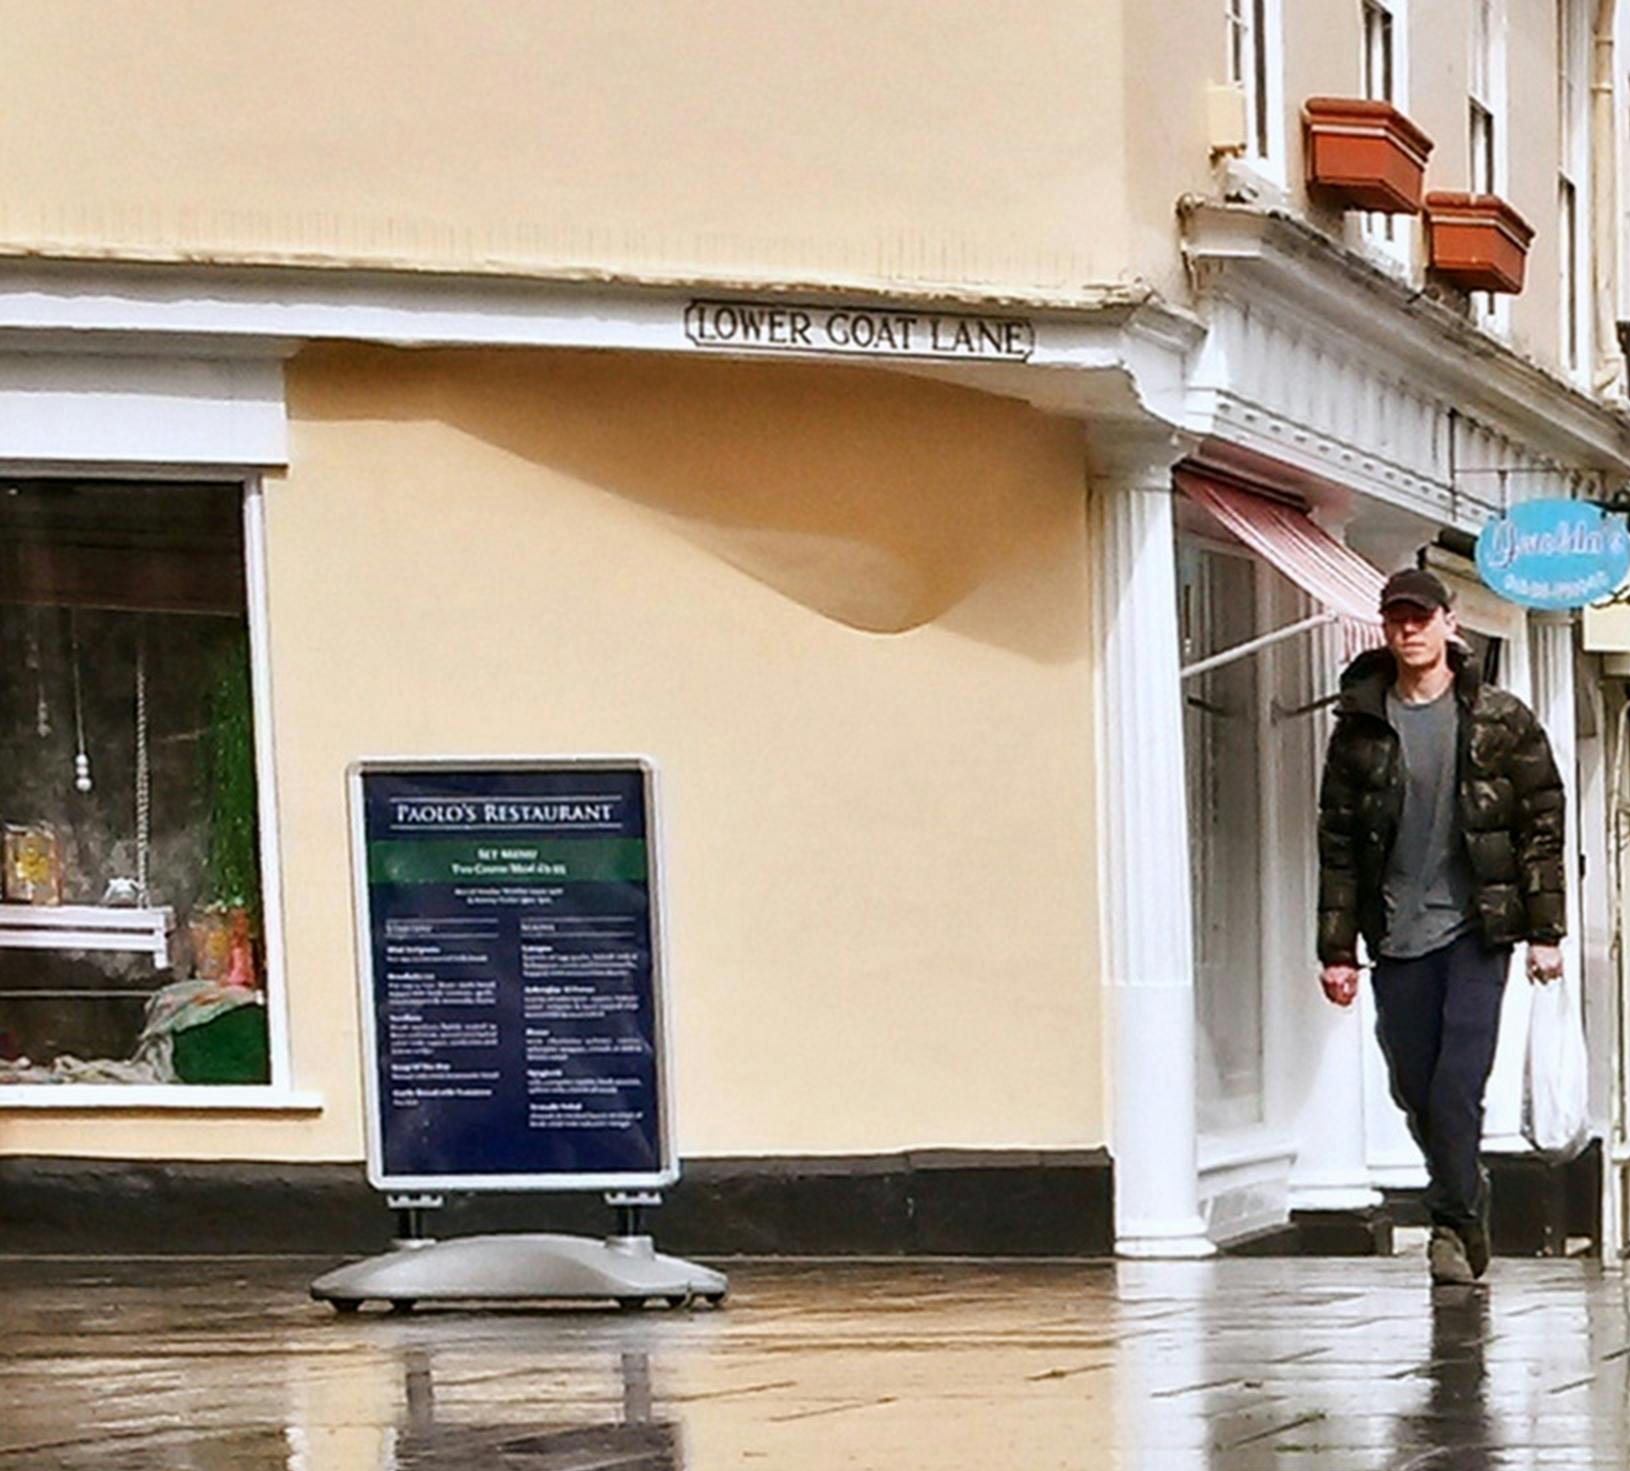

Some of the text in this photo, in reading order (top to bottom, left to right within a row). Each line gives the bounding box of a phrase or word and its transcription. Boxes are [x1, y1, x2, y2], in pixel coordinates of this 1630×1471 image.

[697, 304, 1028, 354] LOWER GOAT LANE
[484, 803, 613, 822] RESTAURANT
